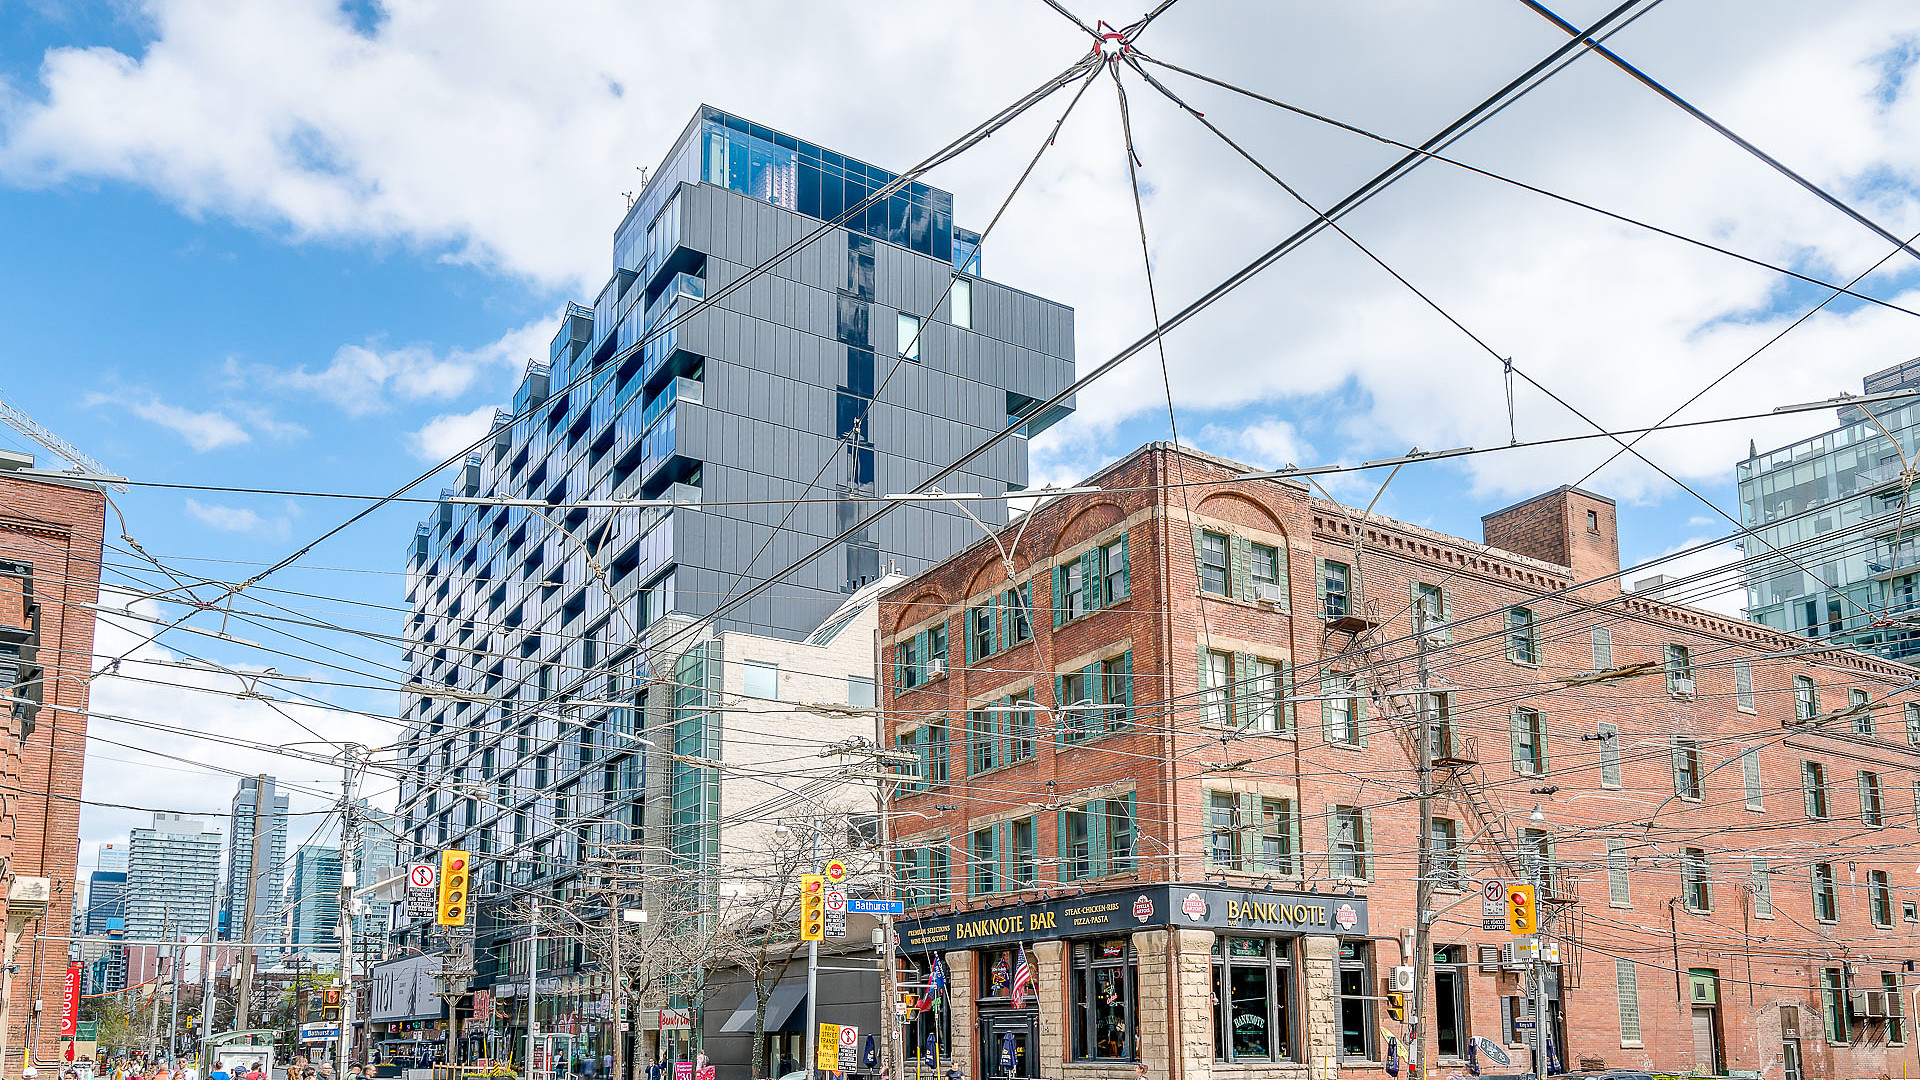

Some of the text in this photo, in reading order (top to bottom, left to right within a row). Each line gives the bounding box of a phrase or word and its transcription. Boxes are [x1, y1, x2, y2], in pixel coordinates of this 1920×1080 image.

[855, 900, 889, 911] Bathurst
[1227, 899, 1327, 924] BANKNOTE
[956, 911, 1058, 940] BANKNOTE BAR
[62, 973, 74, 1017] ROGERS
[662, 1012, 679, 1030] Beauty
[1233, 1014, 1265, 1028] BANKNOTE
[820, 1037, 838, 1045] TRANSIT
[821, 1031, 838, 1039] STREET
